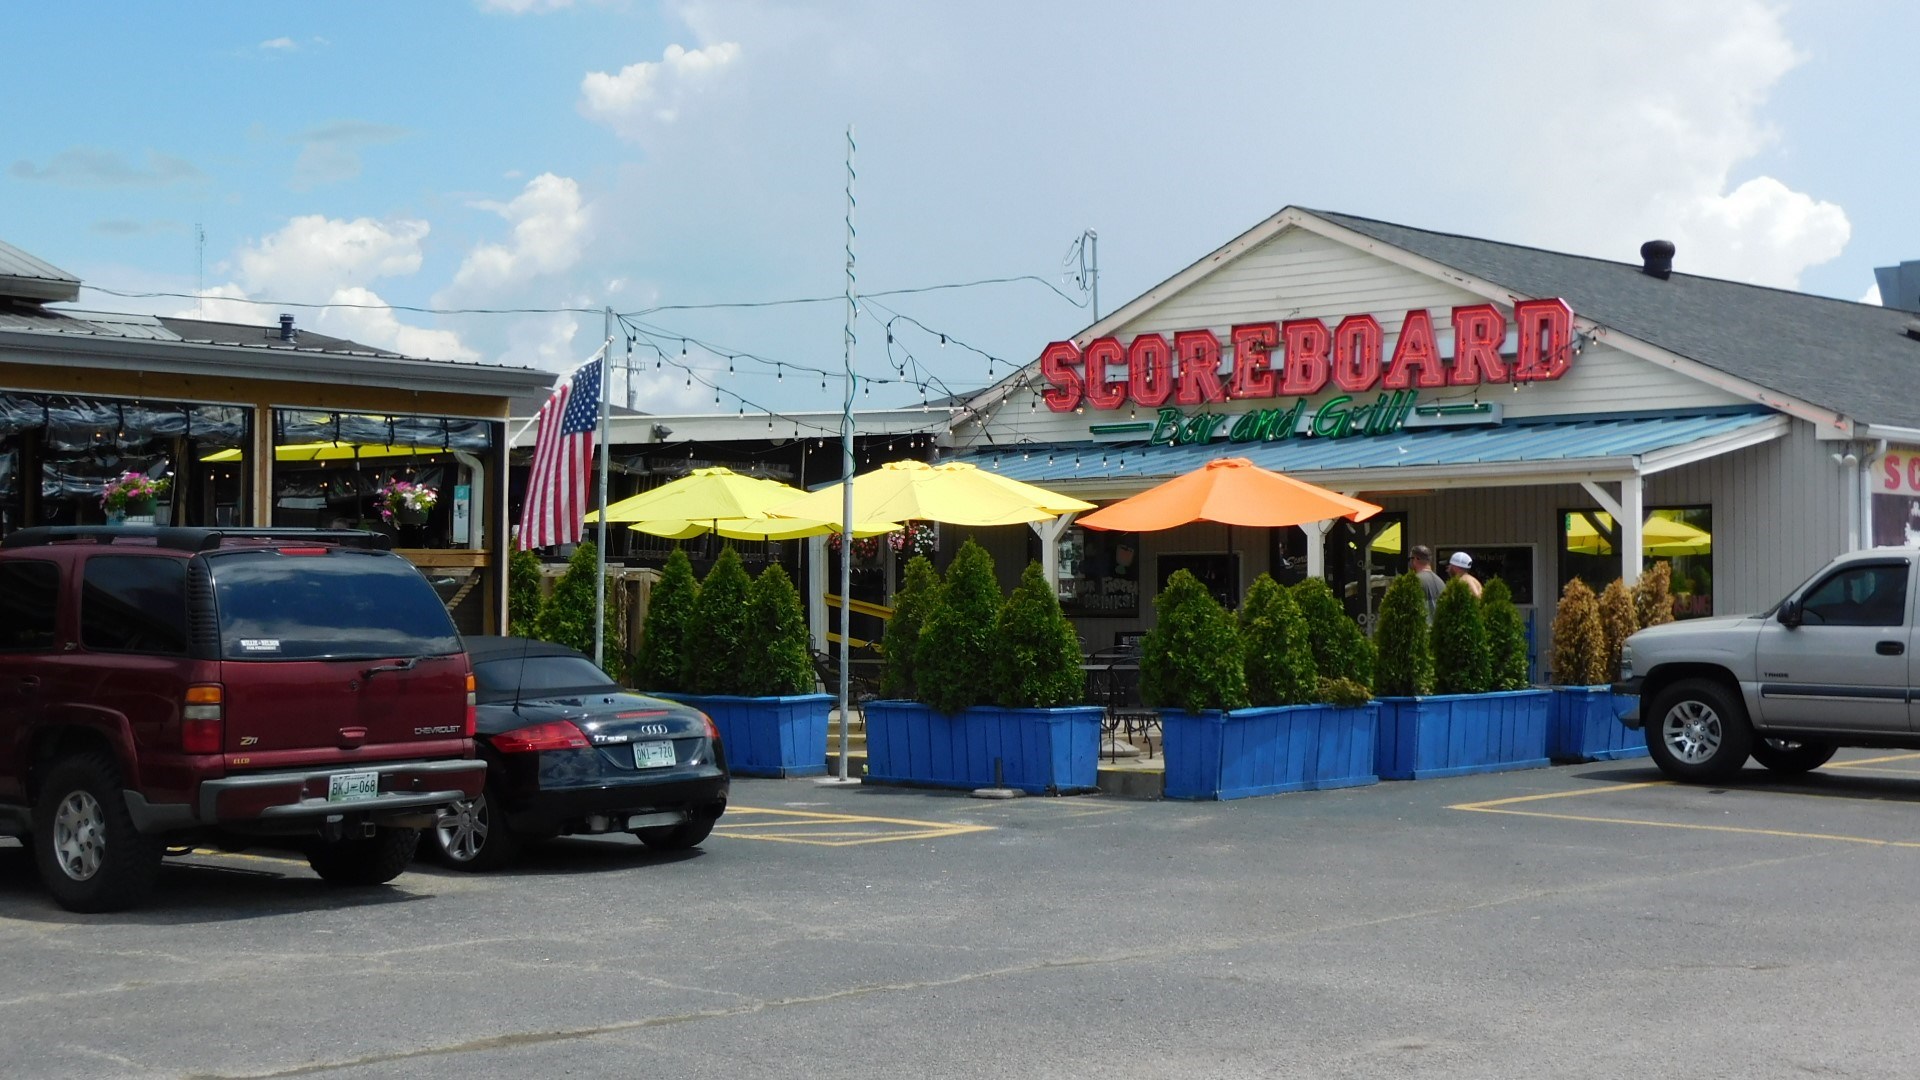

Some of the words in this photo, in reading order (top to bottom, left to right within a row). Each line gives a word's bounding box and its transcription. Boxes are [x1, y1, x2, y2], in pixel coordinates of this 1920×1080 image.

[1041, 297, 1574, 413] SCOREBOARD
[1152, 406, 1225, 446] Bar
[1229, 397, 1309, 444] and
[414, 725, 461, 735] CHEVROLET
